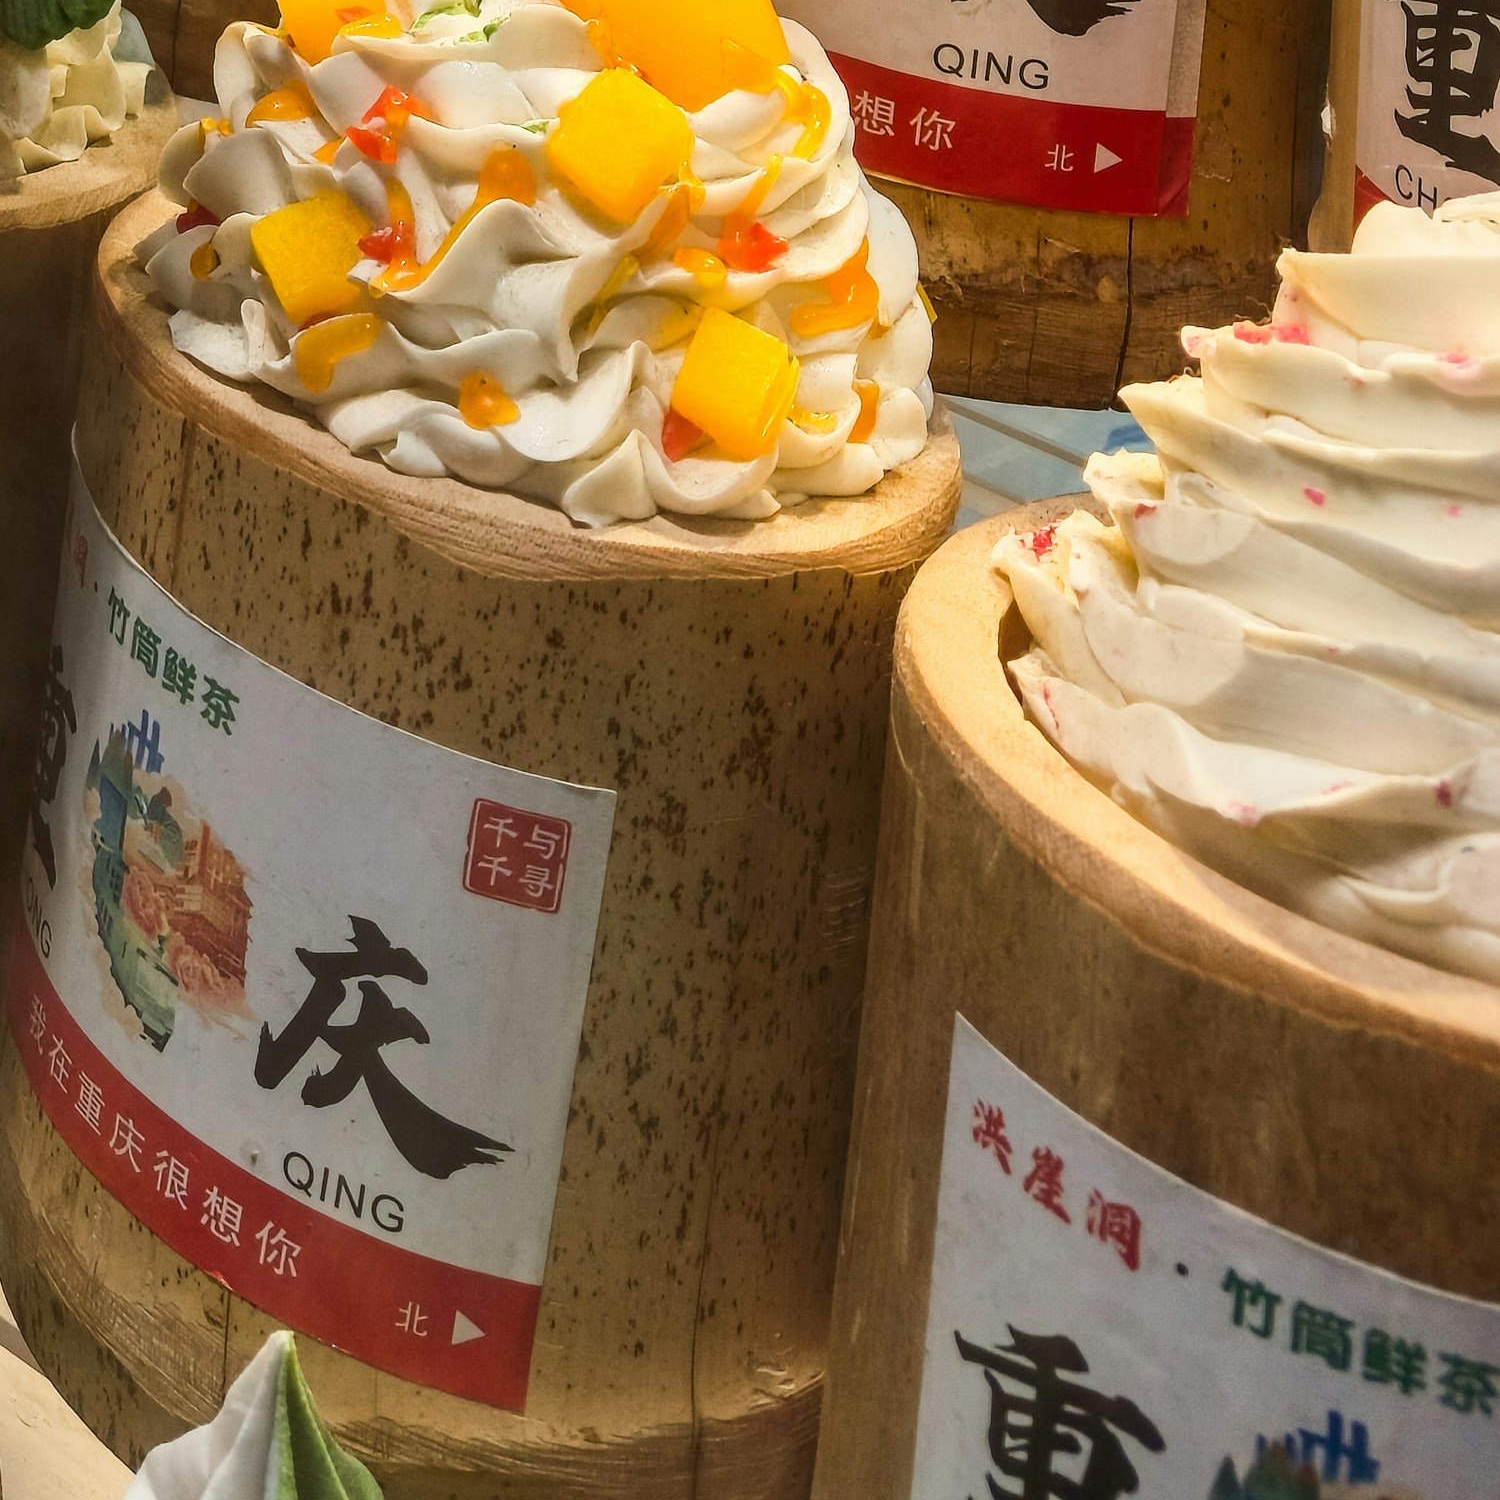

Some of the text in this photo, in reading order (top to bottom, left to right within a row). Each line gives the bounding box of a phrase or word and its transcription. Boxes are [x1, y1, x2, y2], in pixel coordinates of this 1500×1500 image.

[932, 42, 1050, 91] QING
[1043, 143, 1075, 173] 北
[106, 584, 241, 737] 竹筒鲜茶
[252, 913, 516, 1181] 庆
[29, 994, 429, 1338] 我在重庆很想你 北
[281, 1150, 406, 1234] QING
[970, 1098, 1500, 1420] 洪崖洞 竹筒鲜茶
